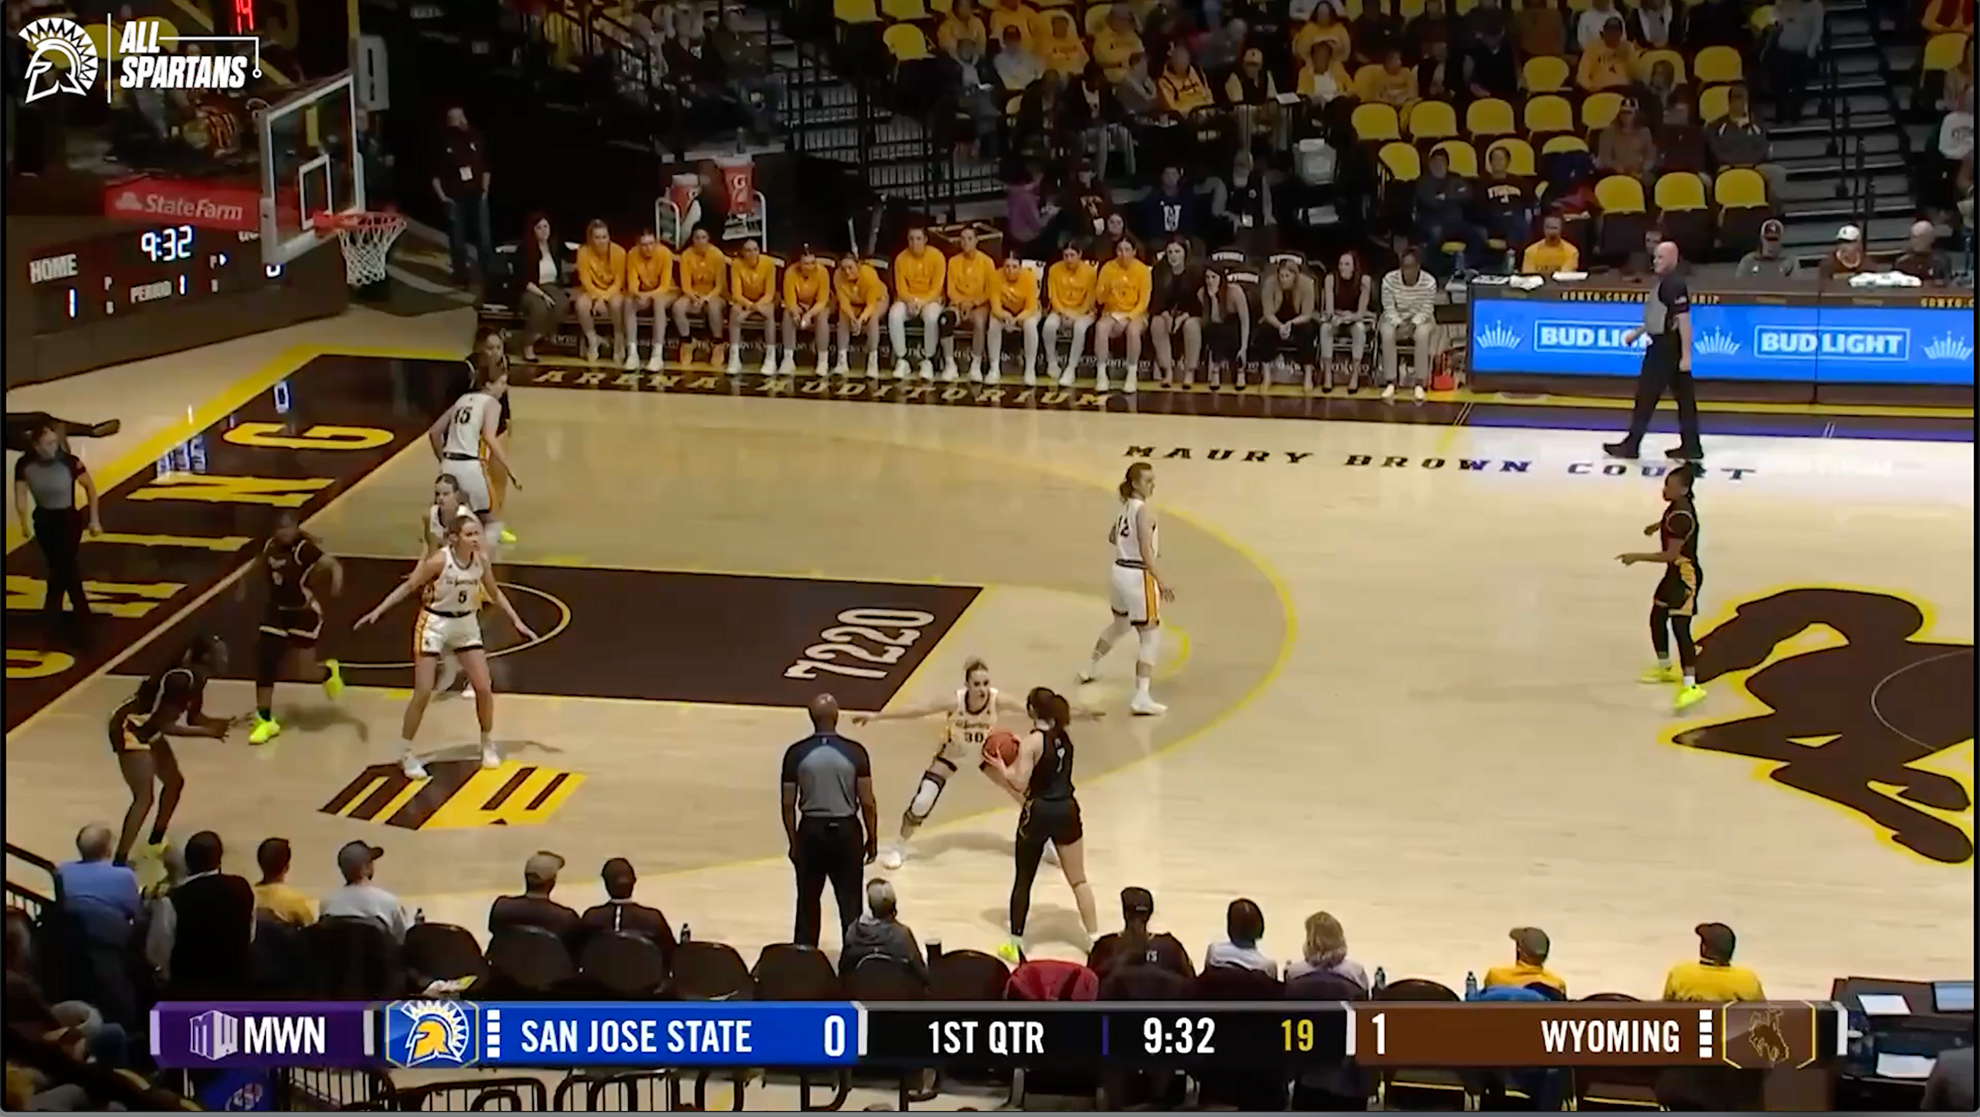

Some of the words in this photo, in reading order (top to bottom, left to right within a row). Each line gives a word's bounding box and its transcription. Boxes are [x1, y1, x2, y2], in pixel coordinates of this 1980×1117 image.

[141, 225, 193, 262] 9:32
[29, 253, 78, 284] HOME
[1541, 327, 1595, 347] BUD
[1761, 332, 1818, 353] BUD
[1822, 332, 1903, 355] LIGHT
[1122, 445, 1314, 464] MAURY
[1343, 453, 1532, 473] BROWN
[1567, 461, 1756, 481] COUT
[784, 608, 935, 680] 7220
